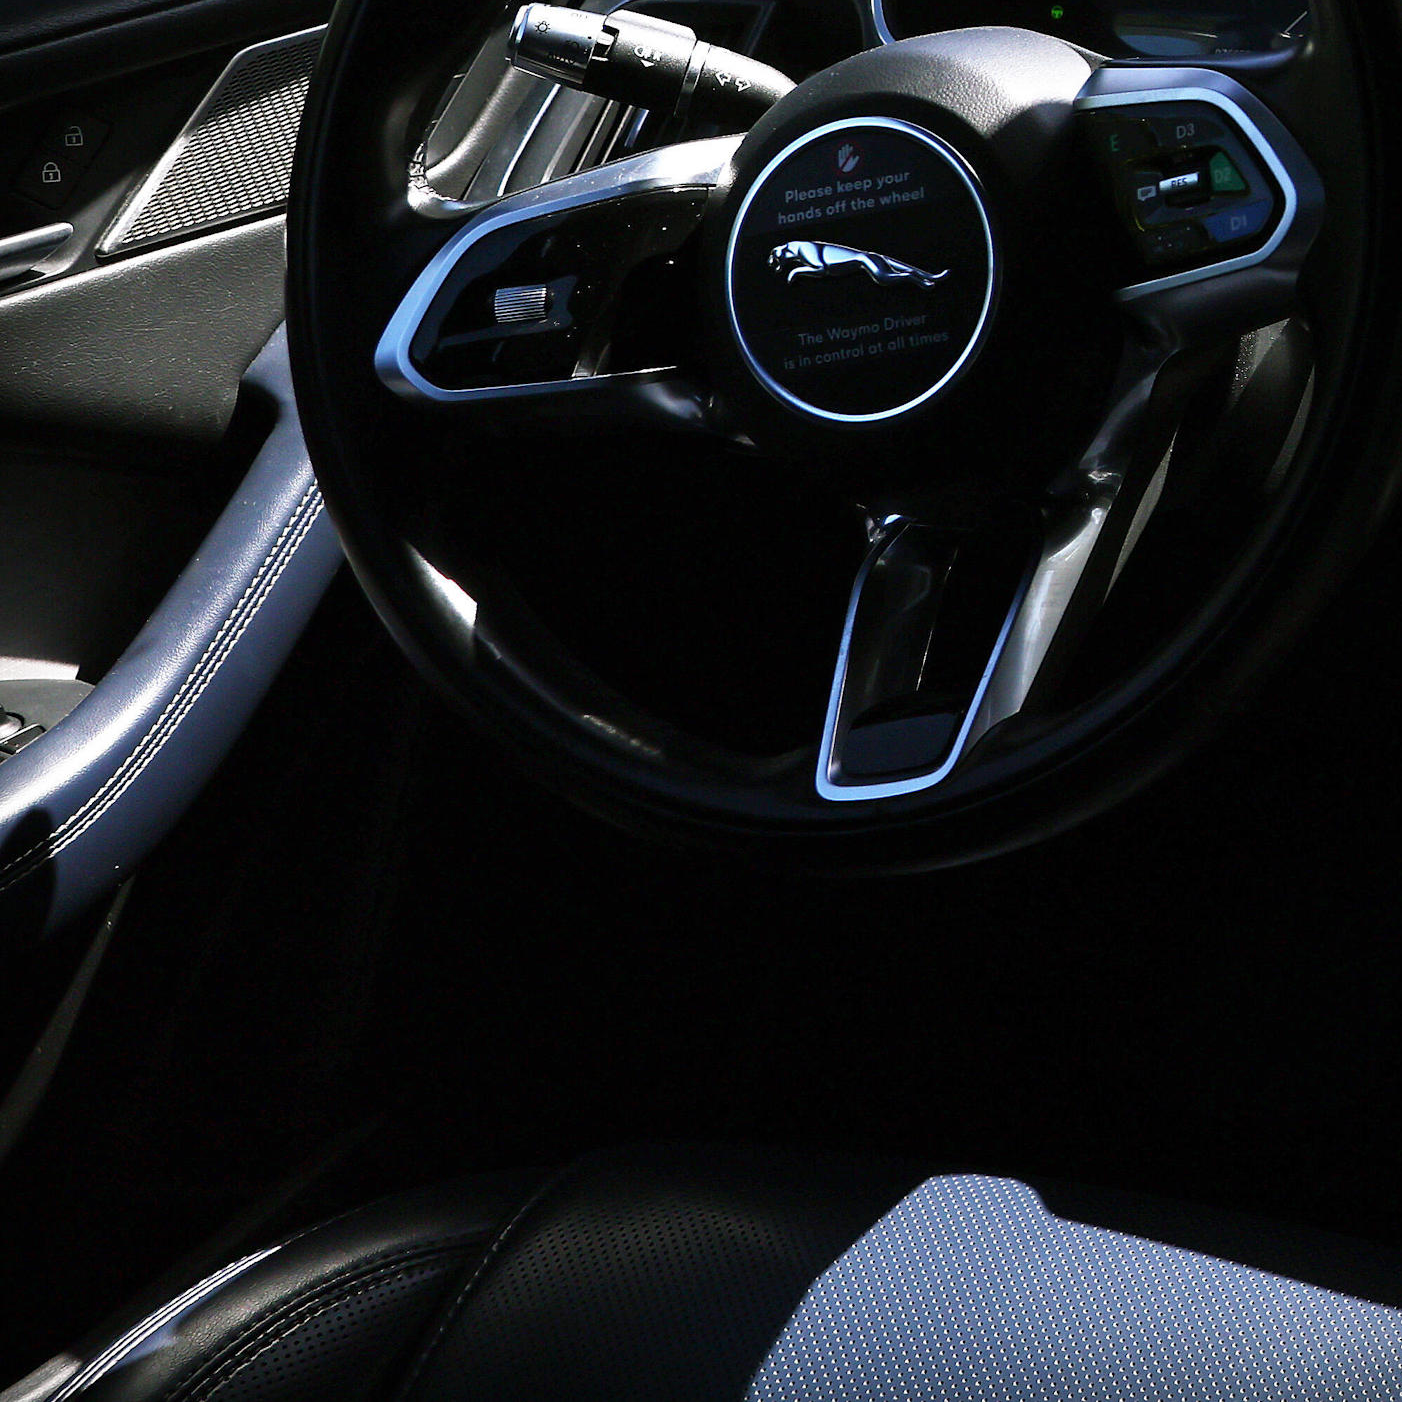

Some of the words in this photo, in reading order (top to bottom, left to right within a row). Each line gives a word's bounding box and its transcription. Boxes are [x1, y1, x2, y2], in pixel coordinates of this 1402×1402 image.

[1176, 123, 1195, 140] D3
[785, 186, 833, 204] Please
[836, 180, 873, 194] keep
[876, 172, 911, 190] your
[777, 206, 823, 225] hands
[826, 200, 847, 216] off
[850, 198, 875, 211] the
[879, 186, 925, 207] wheel
[1230, 215, 1248, 232] D1
[797, 333, 824, 346] The
[825, 323, 880, 342] Waymo
[883, 314, 927, 331] Driver
[784, 357, 795, 370] is
[799, 355, 812, 367] in
[815, 344, 864, 365] control
[867, 342, 884, 355] at
[887, 336, 905, 351] all
[908, 331, 950, 347] times
